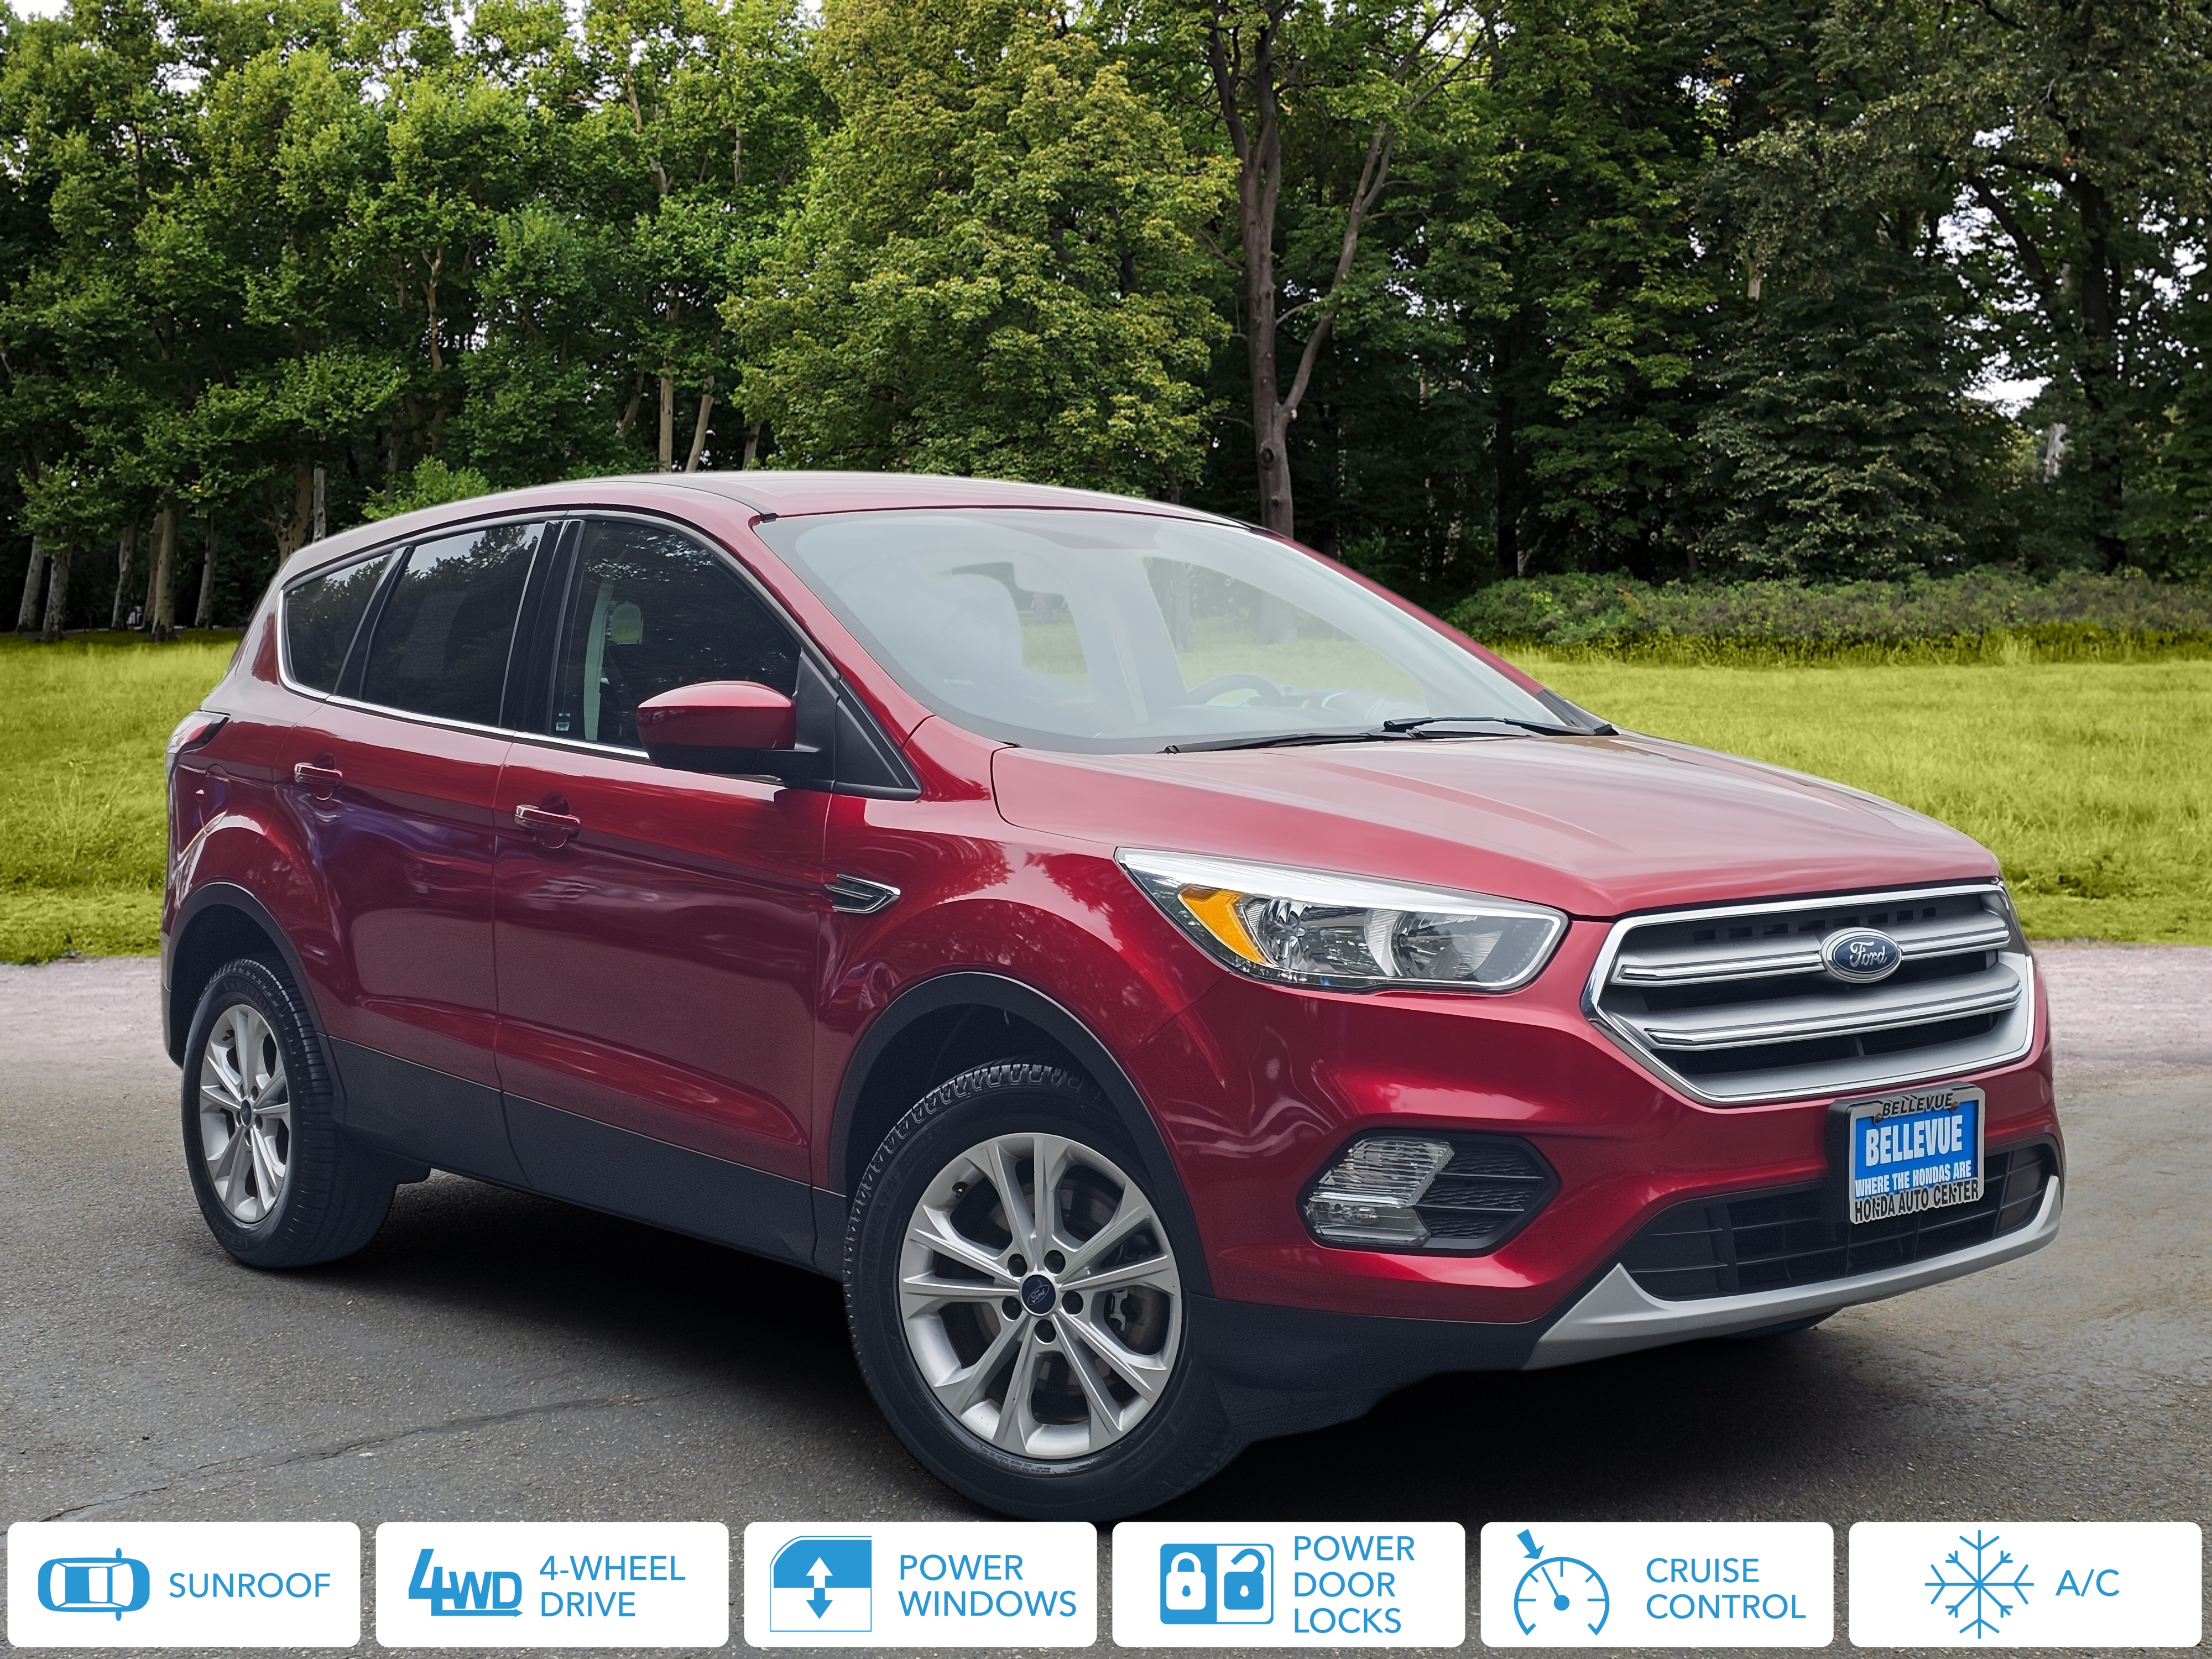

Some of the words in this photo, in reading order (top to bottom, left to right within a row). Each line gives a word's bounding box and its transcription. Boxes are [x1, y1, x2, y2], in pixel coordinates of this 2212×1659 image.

[1849, 941, 1888, 967] Ford
[1882, 1092, 1954, 1117] BELLEVUE
[1866, 1115, 1963, 1167] BELLEVUE
[1855, 1175, 1890, 1198] WHERE
[1892, 1171, 1910, 1191] THE
[1913, 1164, 1950, 1187] HONDAS
[1953, 1160, 1971, 1180] ARE
[1855, 1194, 1896, 1223] HONDA
[1898, 1188, 1929, 1215] AUTO
[1934, 1179, 1979, 1207] CENTER
[1031, 1288, 1045, 1303] Ford
